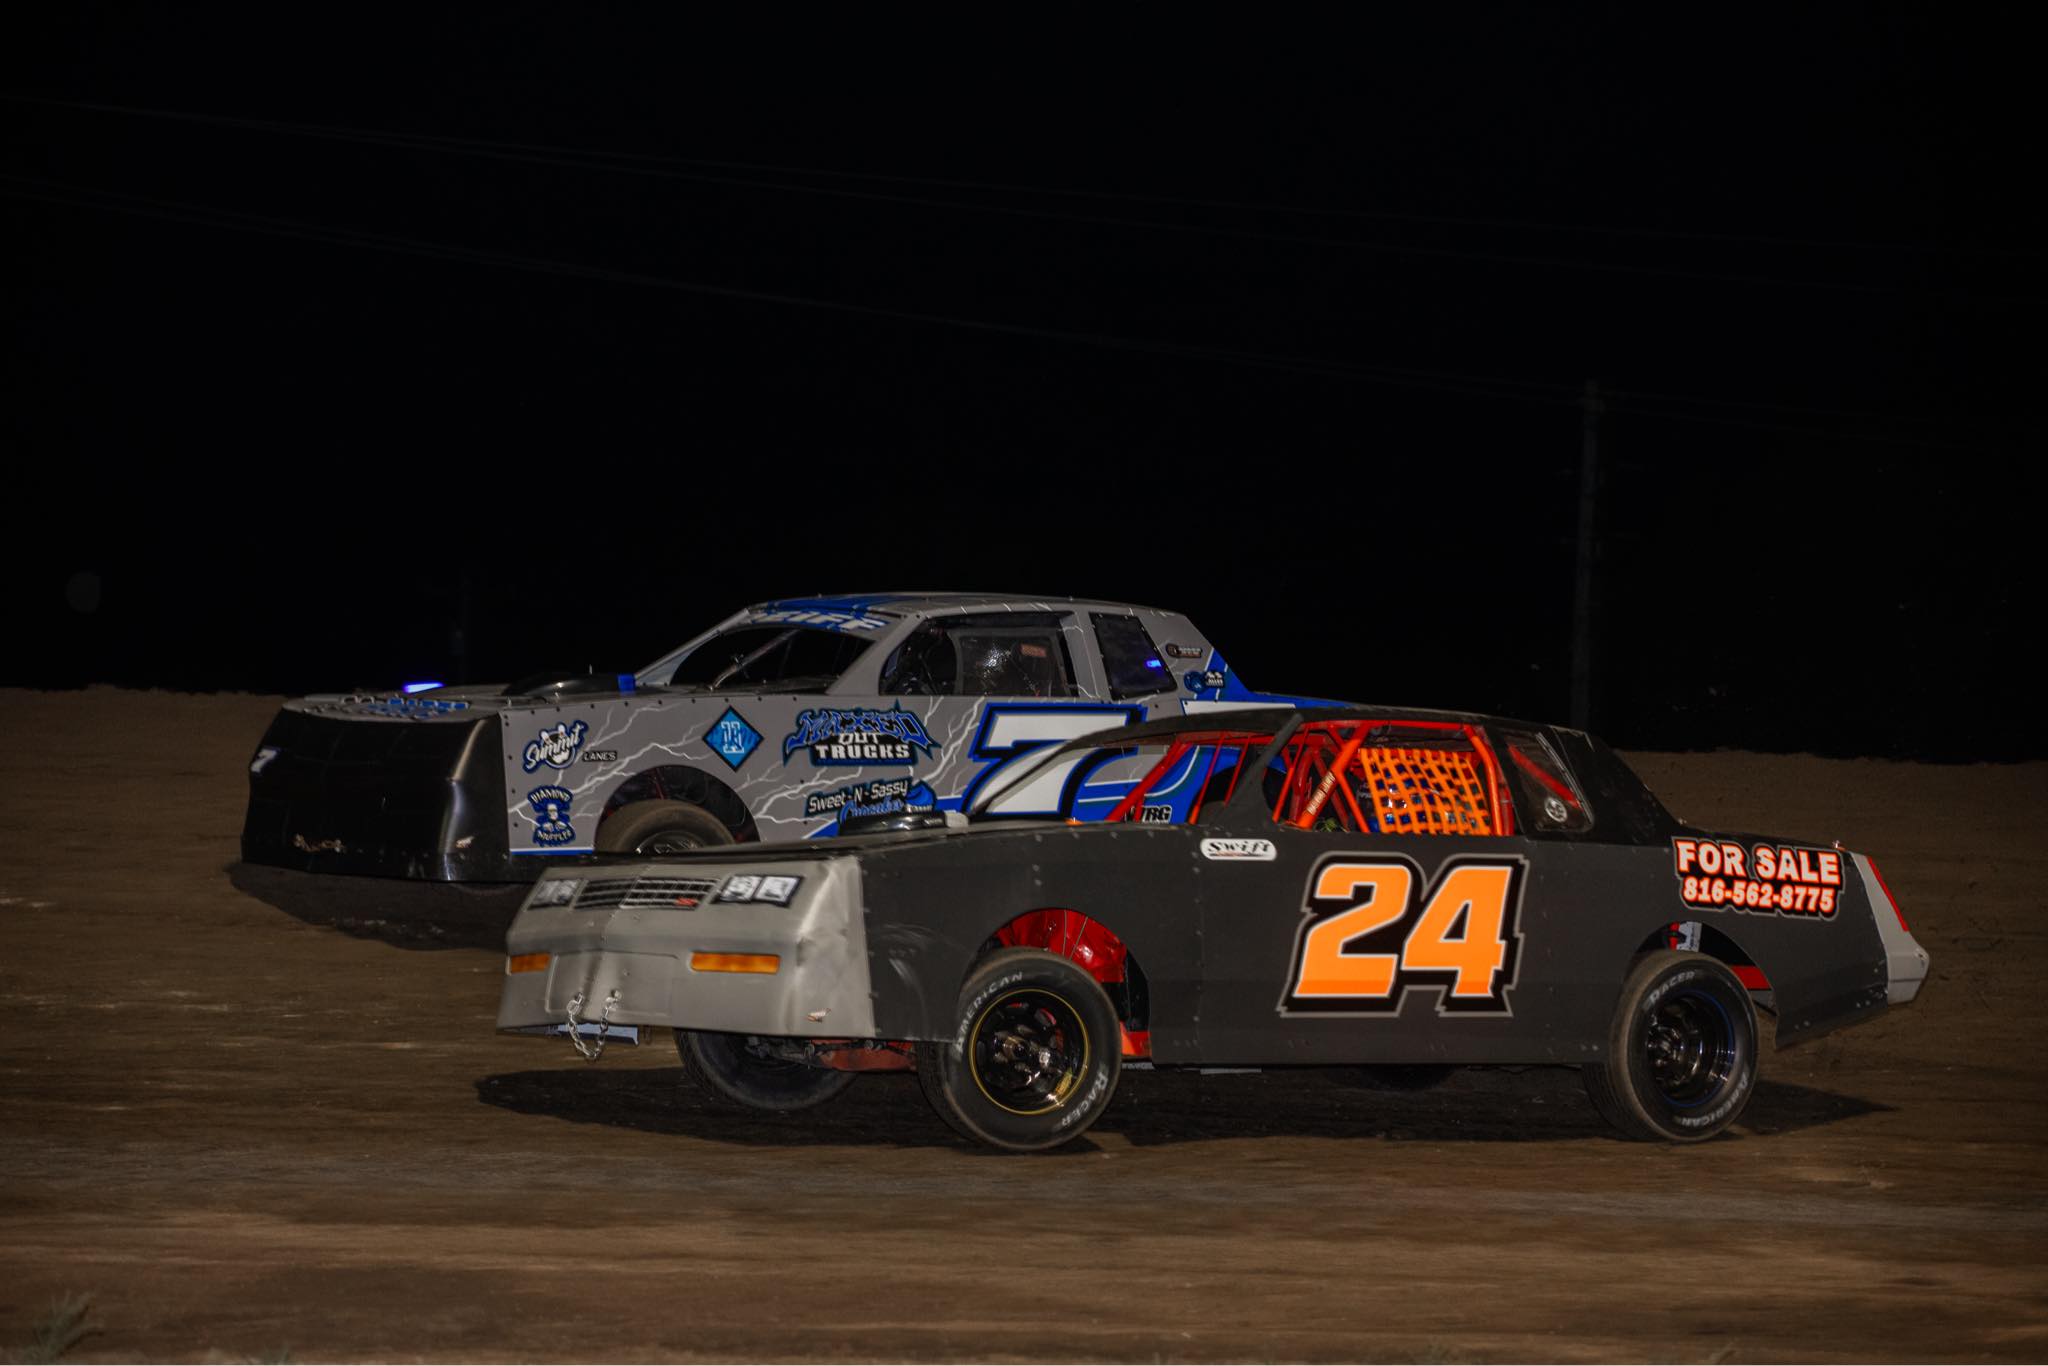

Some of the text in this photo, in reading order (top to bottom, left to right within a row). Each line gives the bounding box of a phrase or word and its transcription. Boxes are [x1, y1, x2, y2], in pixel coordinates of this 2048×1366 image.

[524, 722, 586, 771] Summit
[814, 743, 911, 760] TRUCKS
[838, 732, 880, 744] OUT
[250, 747, 279, 775] 7
[964, 704, 1146, 816] 7
[1674, 839, 1841, 886] FOR SALE
[1682, 875, 1836, 914] 816-562-8775
[1284, 856, 1521, 1010] 24
[1648, 970, 1696, 1006] RACER
[955, 971, 1024, 1053] AMERICAN
